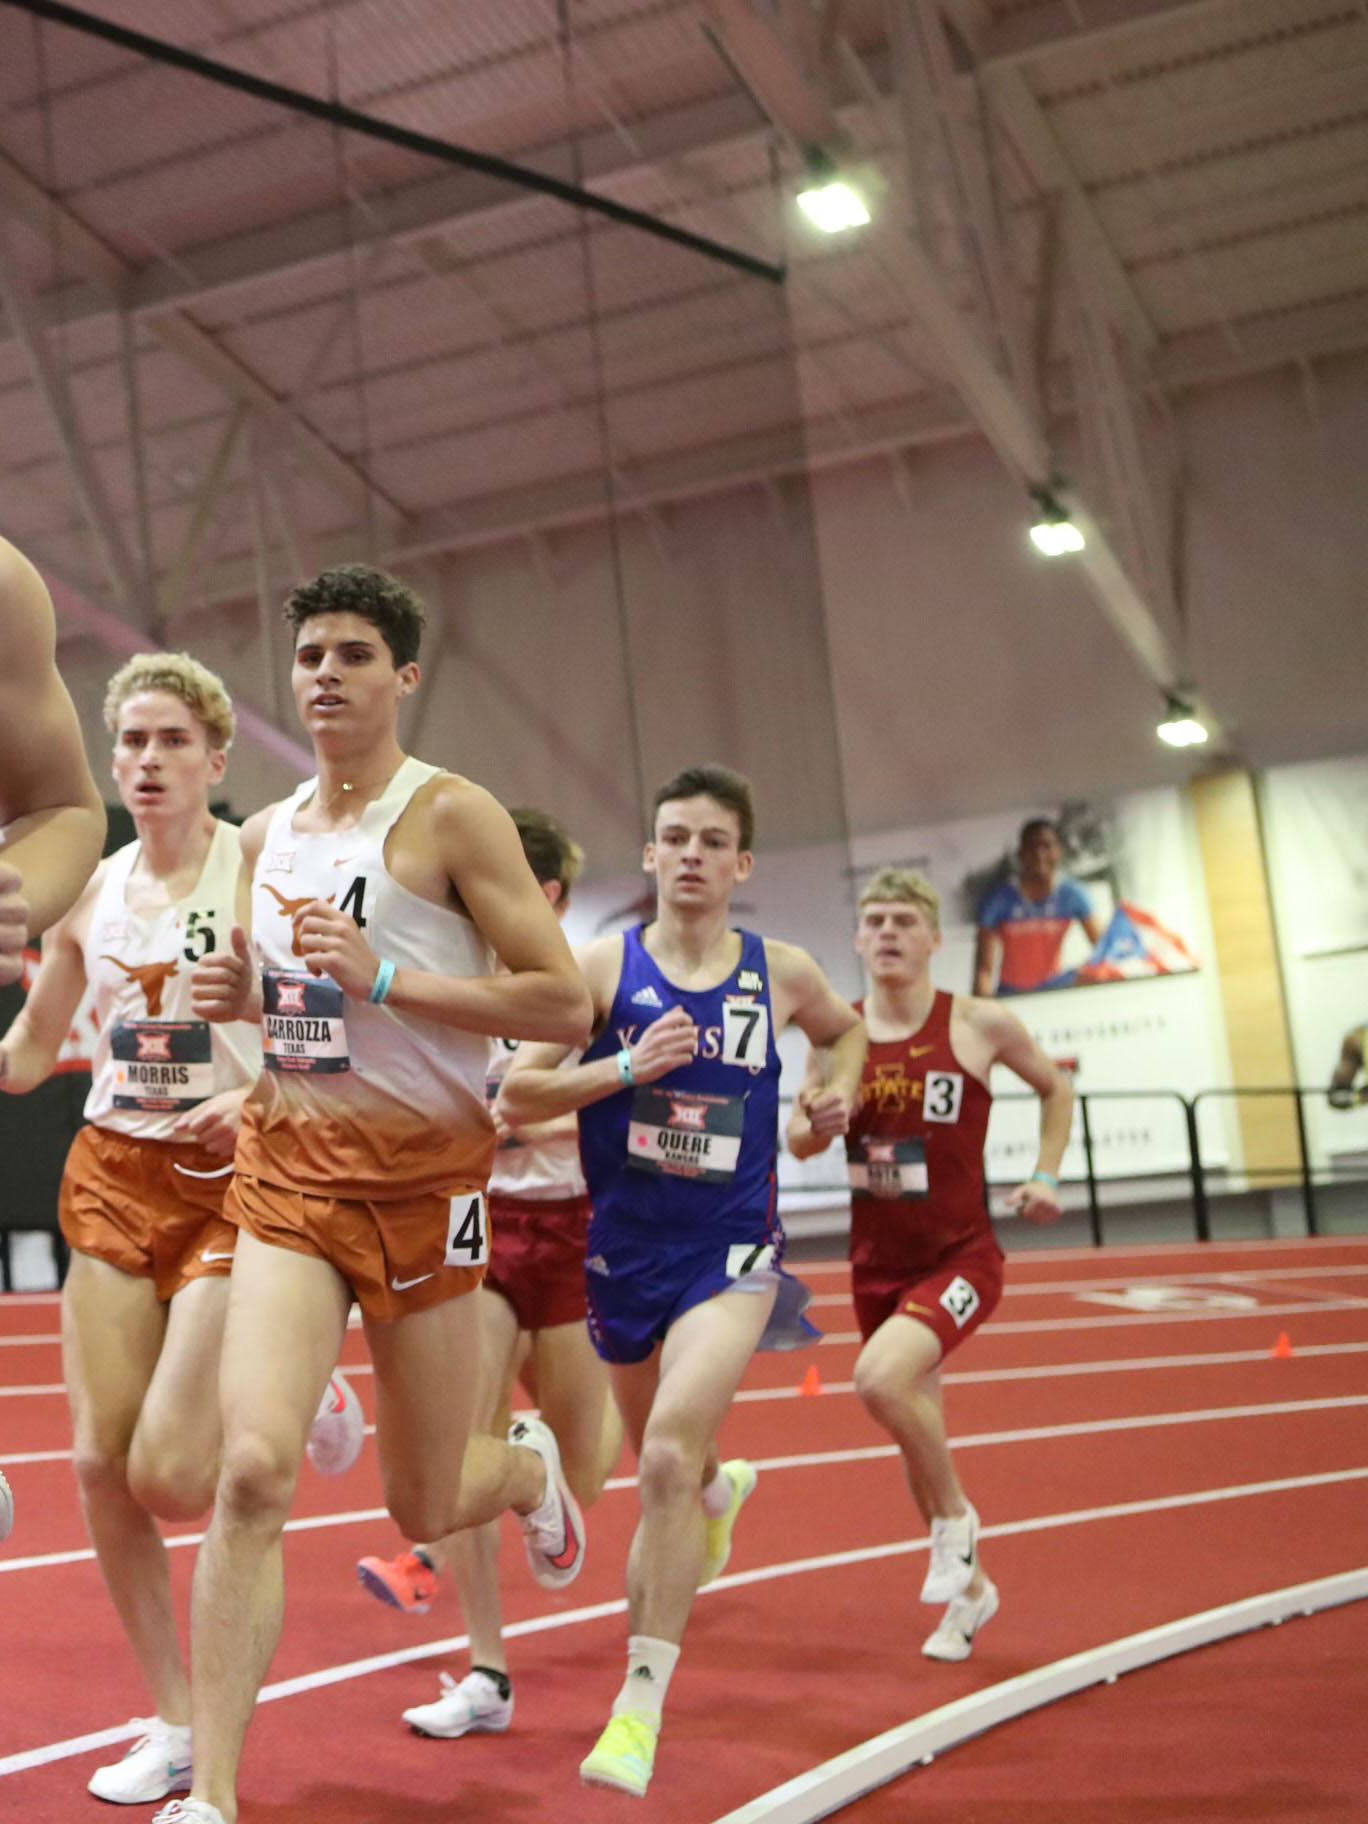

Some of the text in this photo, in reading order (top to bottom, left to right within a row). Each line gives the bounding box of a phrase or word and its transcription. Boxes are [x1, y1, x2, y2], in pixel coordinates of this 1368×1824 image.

[339, 876, 367, 928] 4
[184, 910, 215, 962] 5
[267, 1017, 332, 1042] CARROZZA
[283, 1042, 306, 1054] TEXAS
[730, 1009, 760, 1059] 7
[127, 1065, 190, 1085] MORRIS
[930, 1077, 954, 1116] 3
[657, 1130, 711, 1156] QUERE
[453, 1197, 483, 1261] 4
